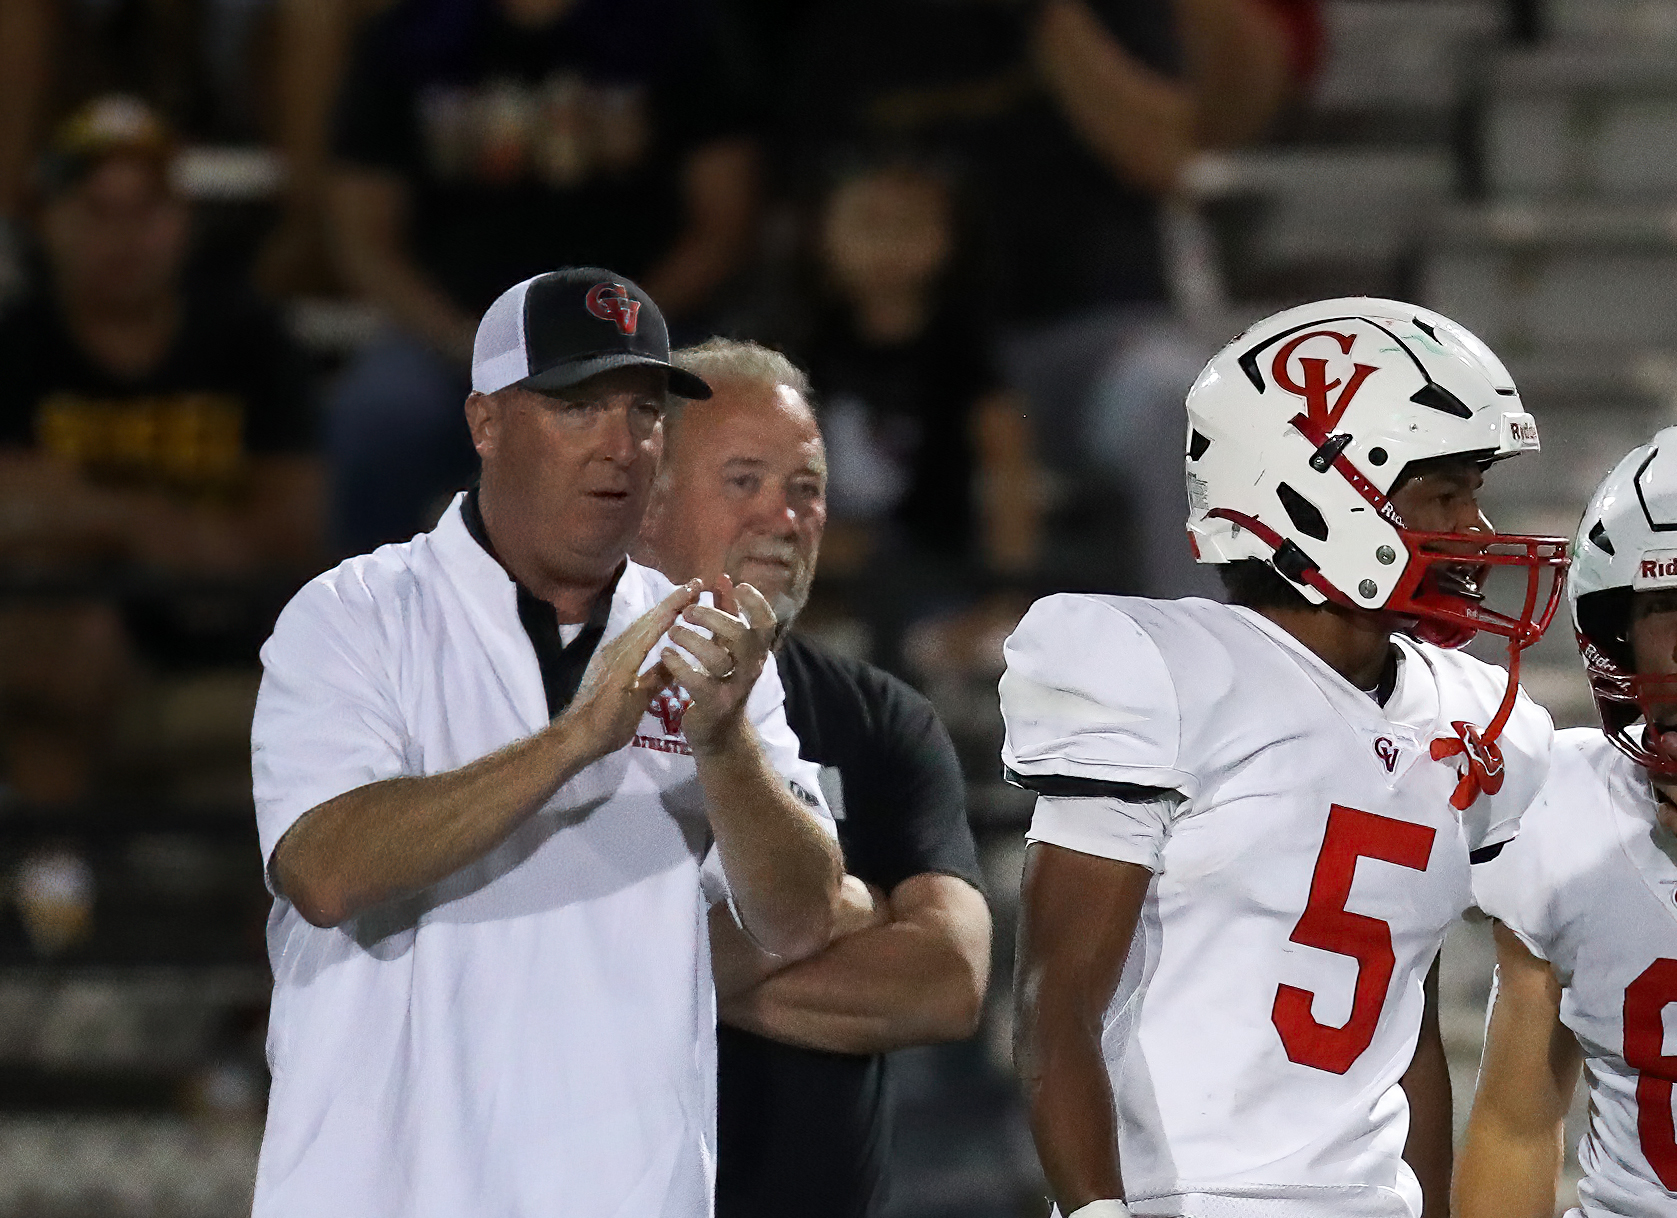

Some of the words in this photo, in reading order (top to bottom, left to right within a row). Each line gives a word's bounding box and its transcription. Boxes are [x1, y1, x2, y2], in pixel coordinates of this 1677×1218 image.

[586, 281, 641, 336] CV
[1271, 330, 1381, 438] CV
[1374, 736, 1400, 773] CV
[1271, 803, 1436, 1075] 5
